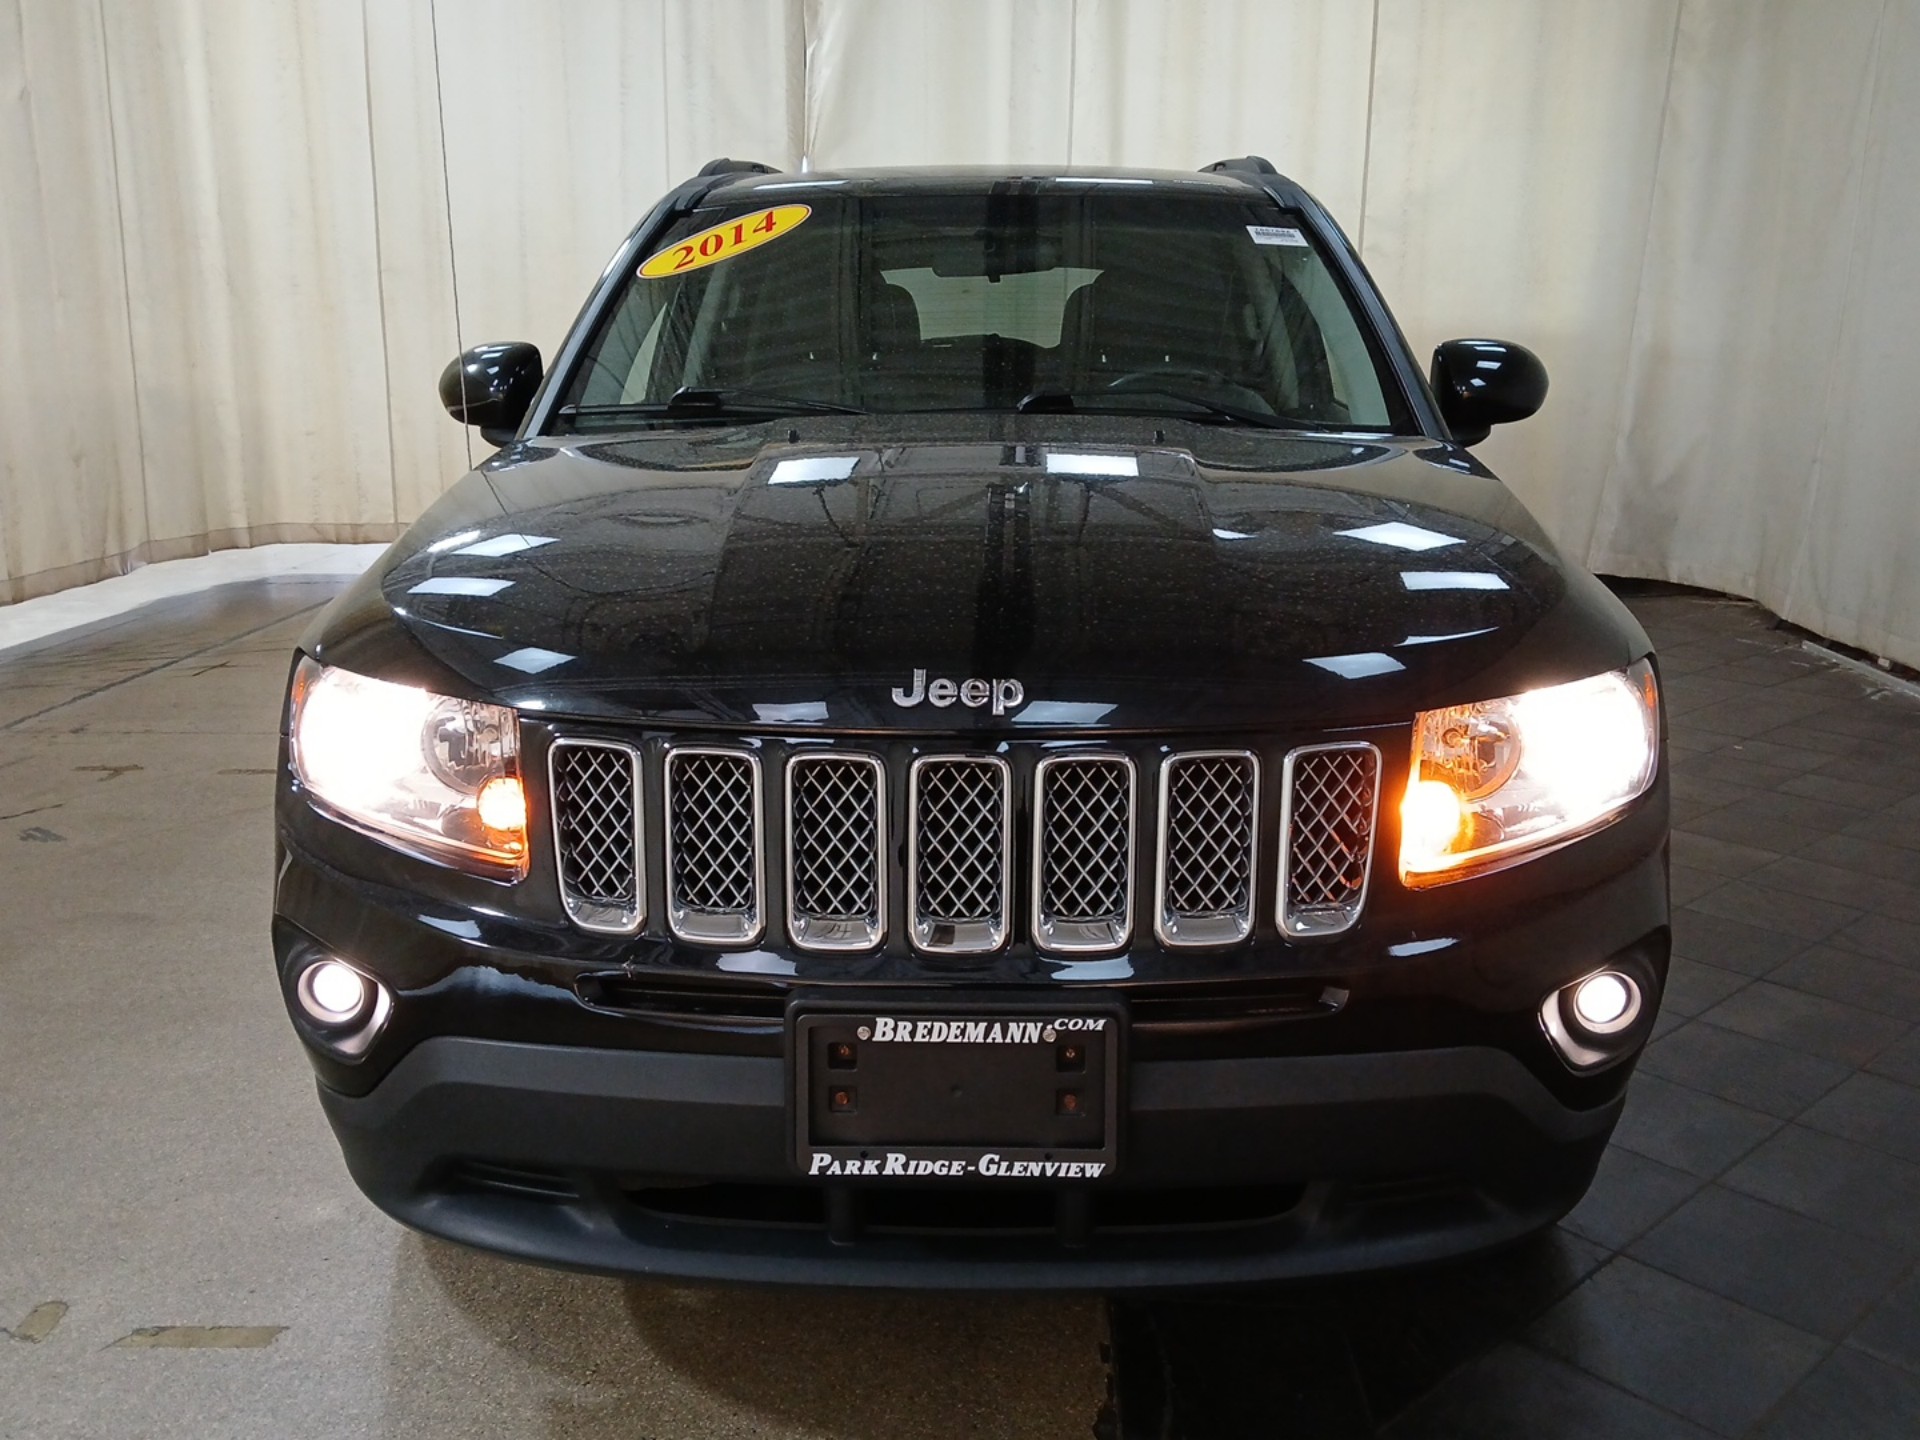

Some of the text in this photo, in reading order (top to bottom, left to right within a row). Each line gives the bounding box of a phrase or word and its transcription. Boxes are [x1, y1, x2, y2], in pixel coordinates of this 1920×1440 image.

[672, 210, 777, 270] 2014
[891, 668, 1025, 715] Jeep
[872, 1017, 1044, 1044] BREDEMANN
[808, 1153, 882, 1176] PARK
